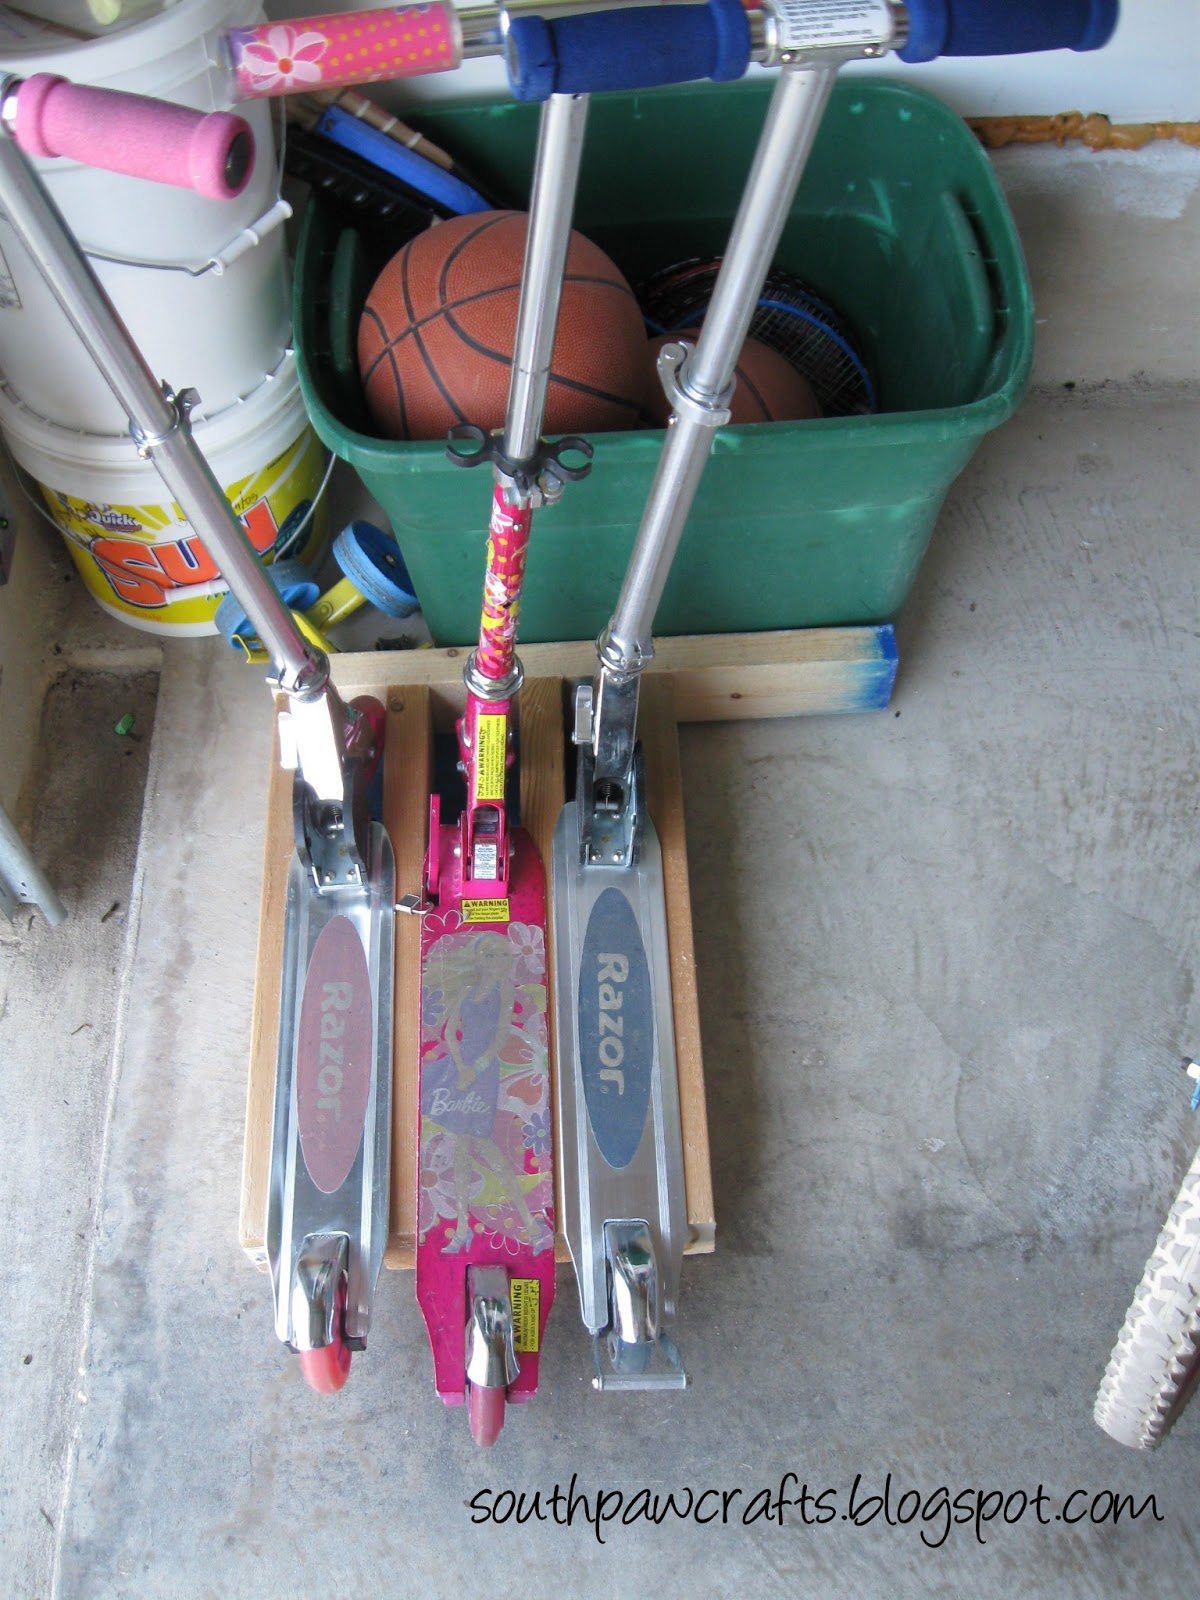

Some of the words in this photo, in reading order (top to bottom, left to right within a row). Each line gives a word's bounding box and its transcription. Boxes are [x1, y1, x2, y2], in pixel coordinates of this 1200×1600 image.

[87, 510, 137, 527] Quick
[478, 735, 486, 768] WARNING
[596, 952, 630, 1096] Razor
[316, 981, 352, 1121] Razor
[430, 1088, 490, 1115] Barbie
[512, 1284, 522, 1333] WARNING
